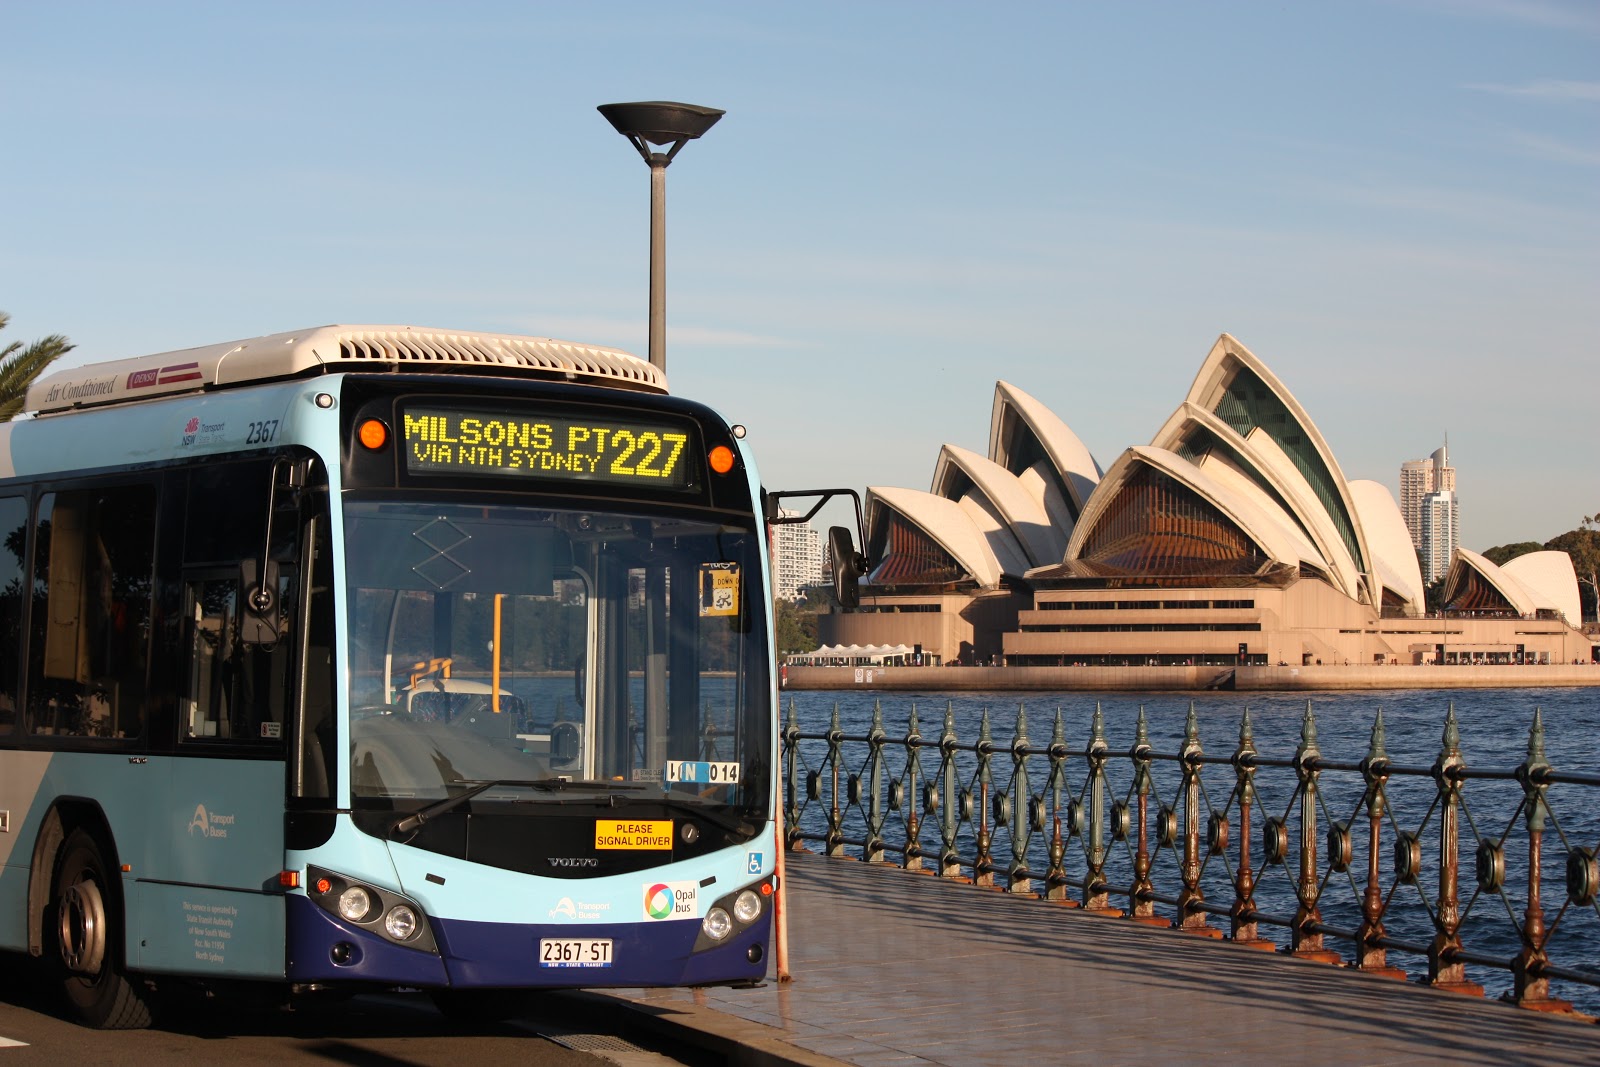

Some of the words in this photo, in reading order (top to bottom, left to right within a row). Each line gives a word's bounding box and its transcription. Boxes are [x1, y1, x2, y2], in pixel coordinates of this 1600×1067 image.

[133, 372, 156, 384] DENSO
[45, 384, 61, 402] Air
[62, 375, 118, 400] Conditioned
[201, 422, 225, 433] Transport
[245, 420, 279, 444] 2367
[404, 414, 553, 449] MILSONS
[568, 427, 610, 453] PT
[182, 434, 196, 446] NSW
[414, 443, 452, 463] VIA
[458, 446, 502, 466] NTH
[509, 450, 601, 473] SYDNEY
[611, 429, 687, 477] 227
[209, 811, 235, 826] Transport
[210, 826, 227, 838] Buses
[616, 824, 653, 834] PLEASE
[597, 836, 633, 846] SIGNAL
[636, 836, 671, 846] DRIVER
[548, 857, 599, 867] VOLVO
[675, 888, 696, 902] Opal
[577, 902, 610, 911] Transport
[675, 902, 691, 913] bus
[578, 911, 601, 919] Buses
